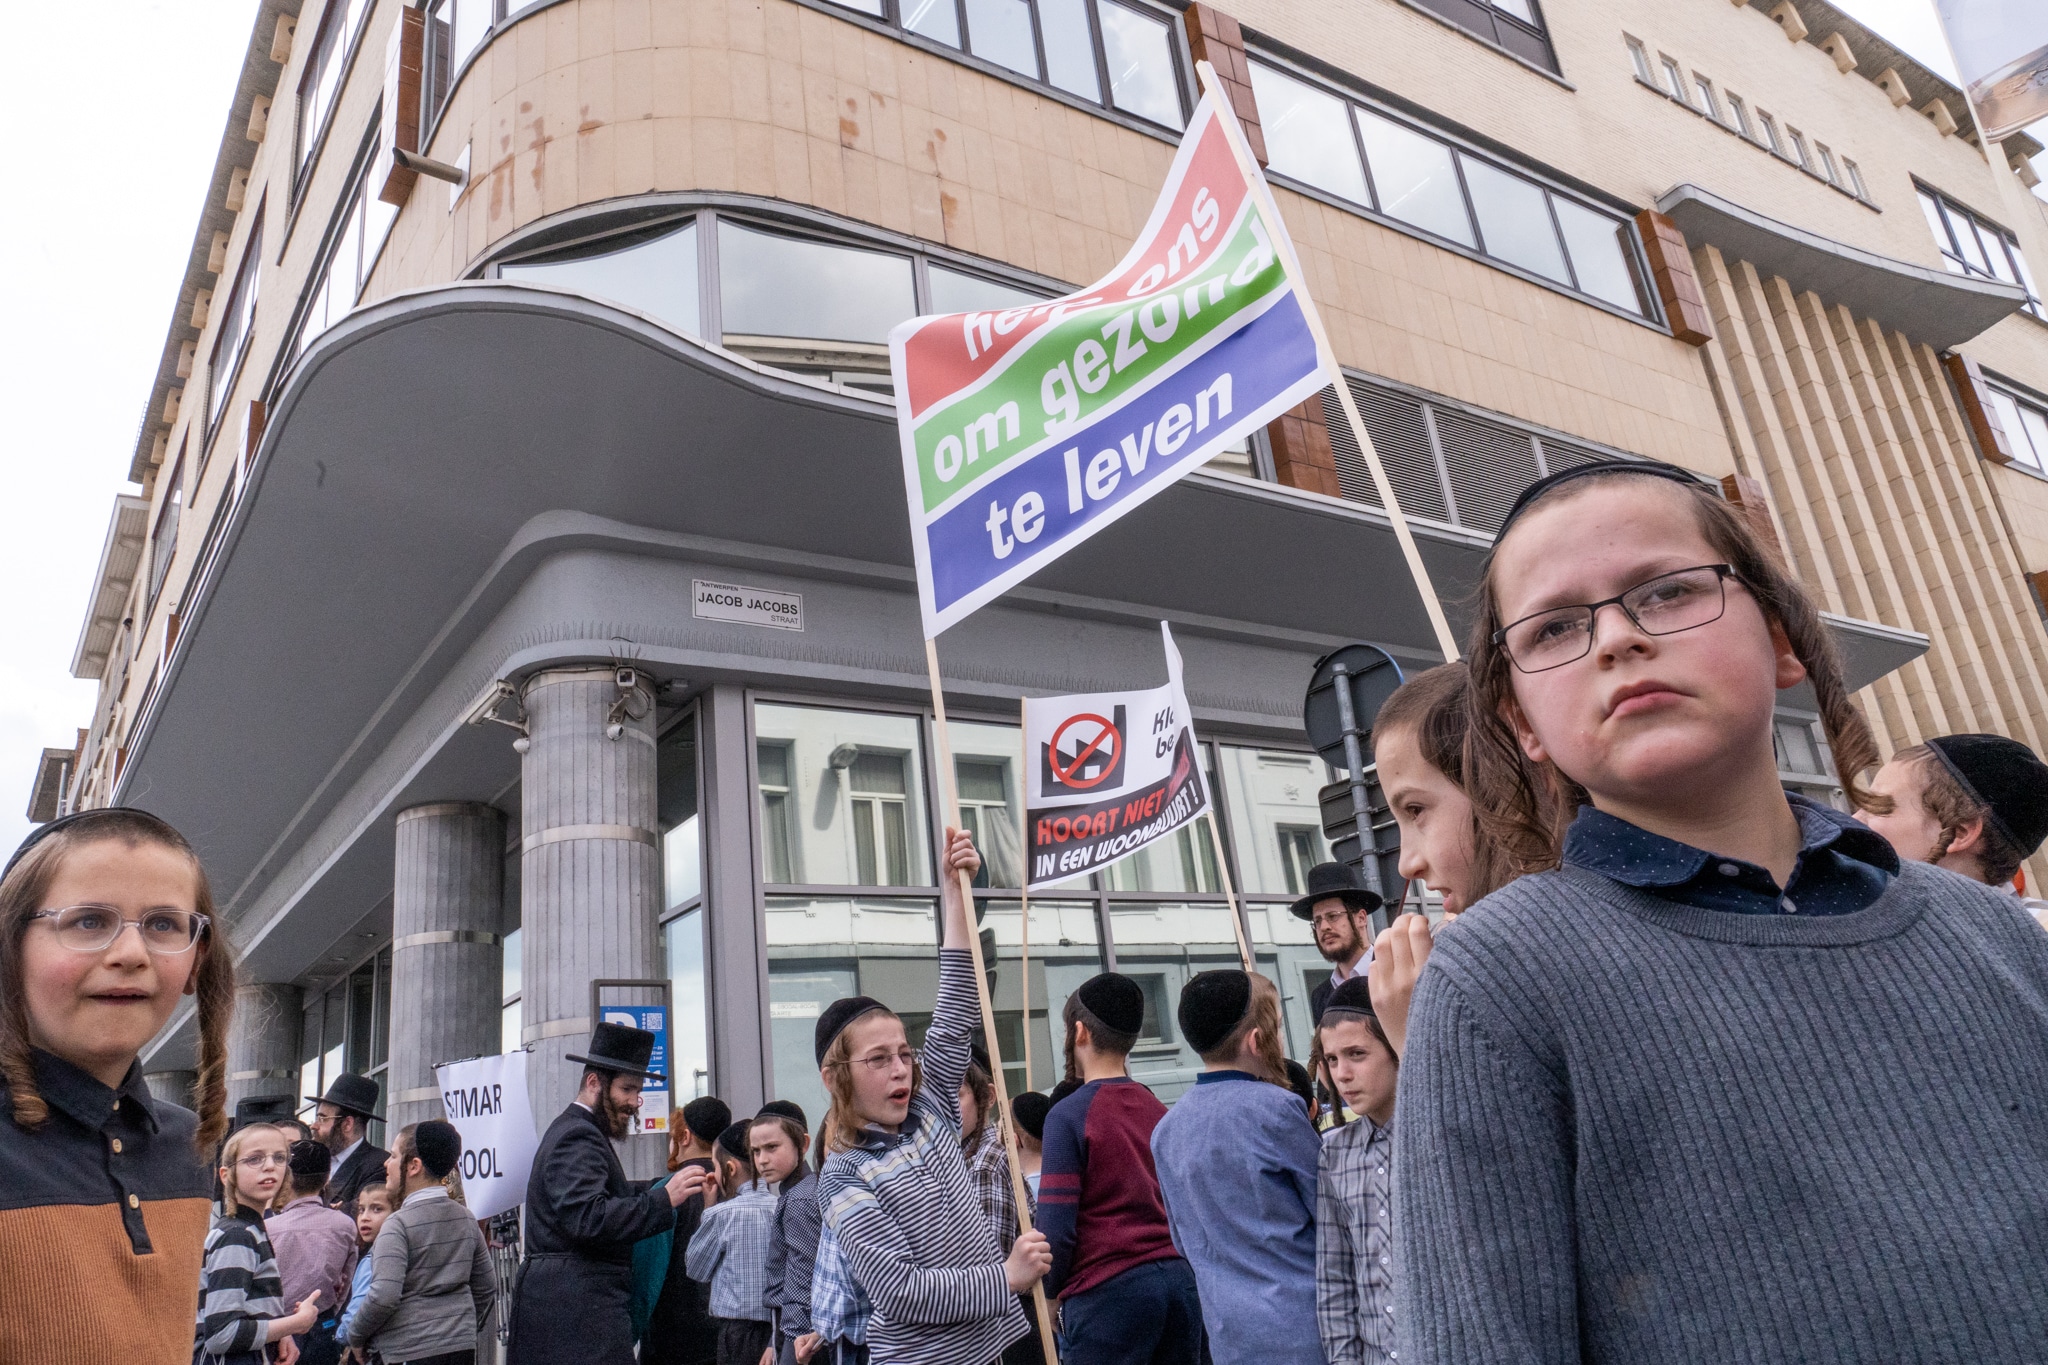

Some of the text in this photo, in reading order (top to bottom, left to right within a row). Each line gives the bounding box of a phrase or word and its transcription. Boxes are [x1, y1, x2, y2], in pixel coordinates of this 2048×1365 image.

[1126, 187, 1220, 297] ons
[934, 214, 1275, 482] om gezond
[986, 373, 1233, 560] te leven
[698, 592, 798, 615] JACOB JACOBS
[771, 614, 799, 625] STRAAT
[1036, 788, 1166, 846] HOORT NIET
[1035, 855, 1056, 878] IN
[1059, 845, 1094, 871] EEN
[444, 1083, 502, 1119] STMAR
